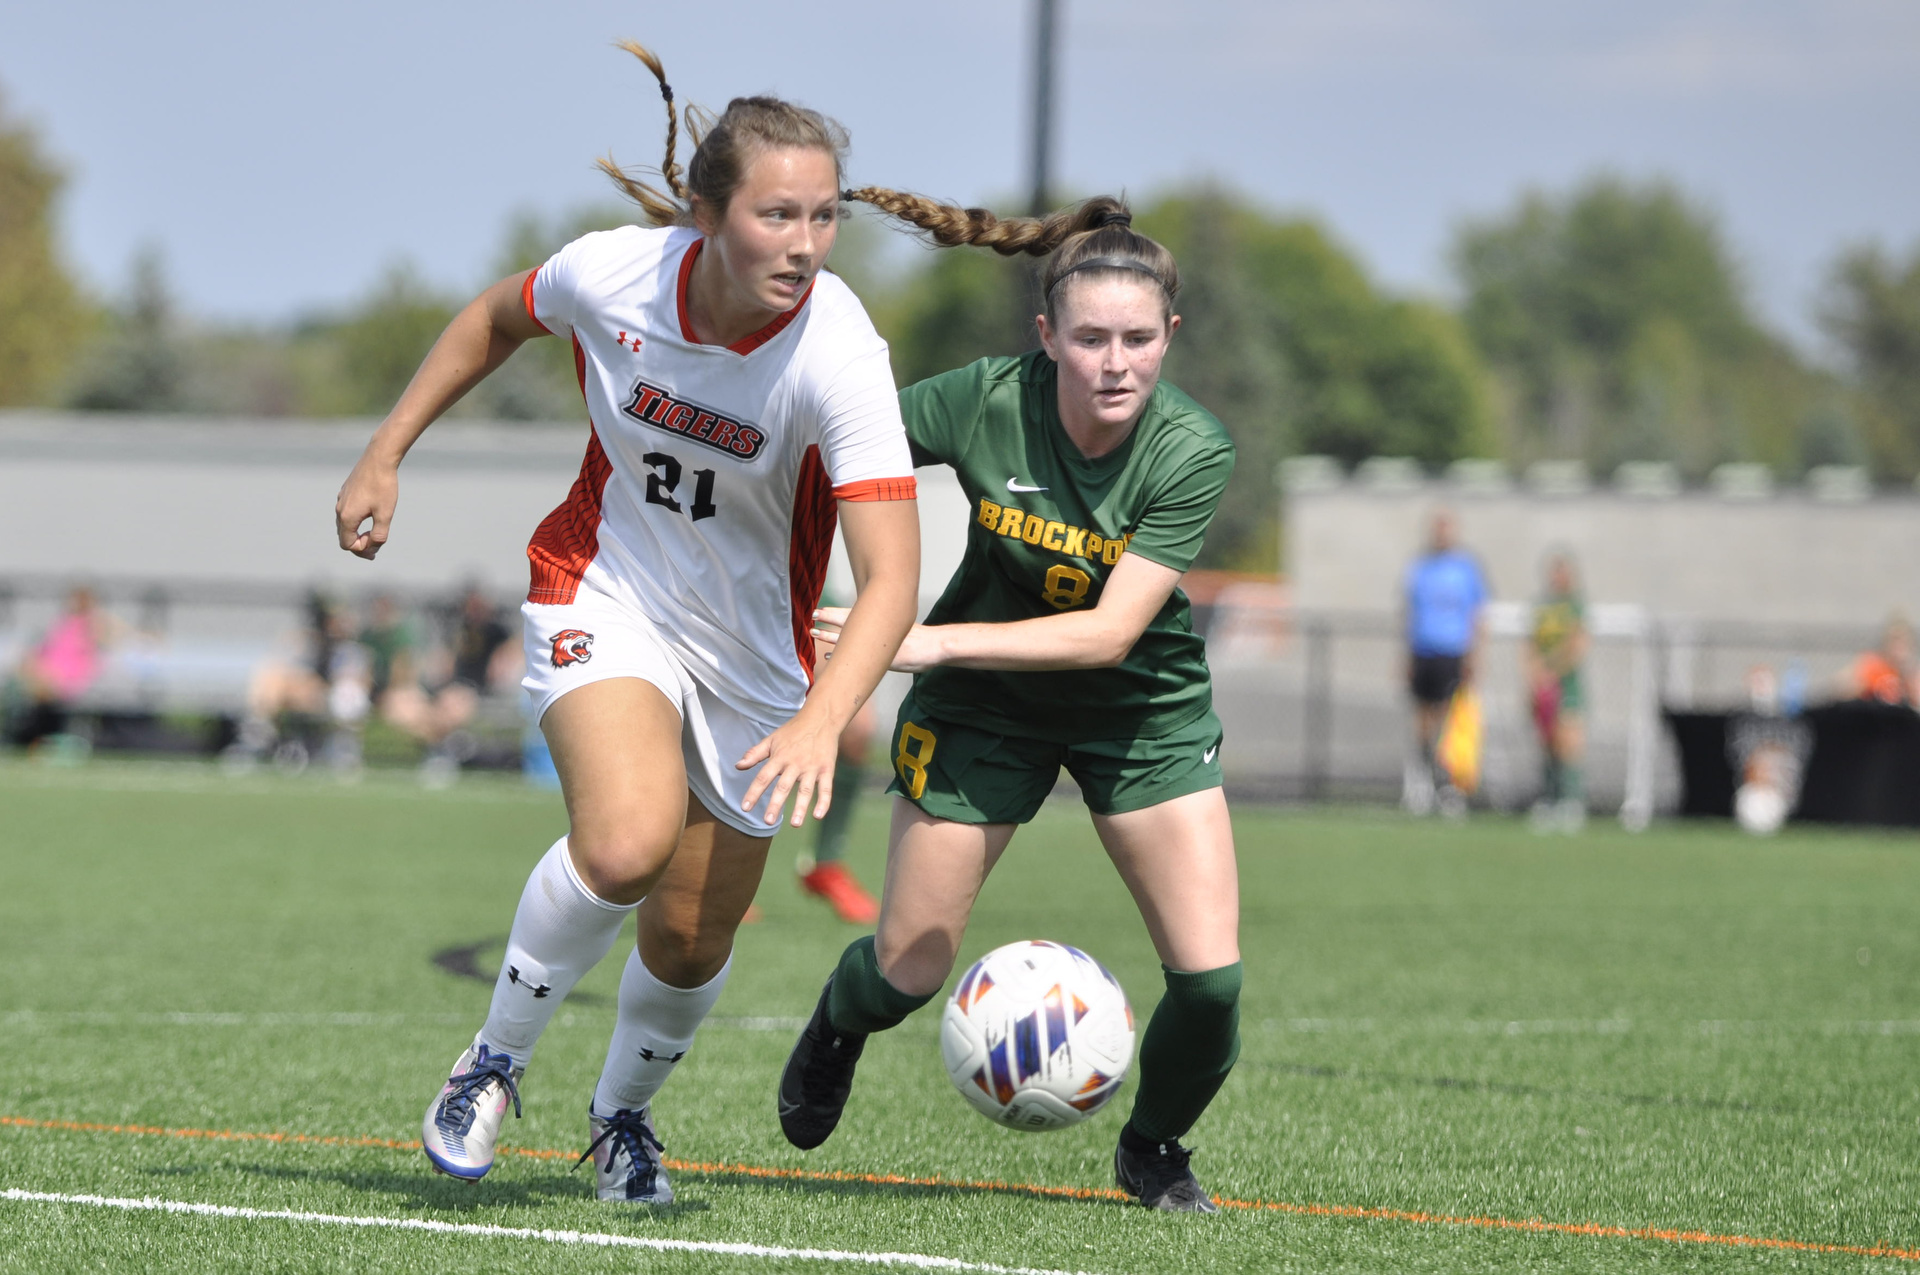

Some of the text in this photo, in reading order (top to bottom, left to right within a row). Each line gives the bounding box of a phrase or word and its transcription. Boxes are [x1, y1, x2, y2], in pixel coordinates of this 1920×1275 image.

[630, 384, 761, 456] TIGERS
[642, 451, 717, 523] 21
[976, 497, 1136, 566] BROCKPO
[1041, 563, 1091, 611] 8
[895, 720, 937, 800] 8
